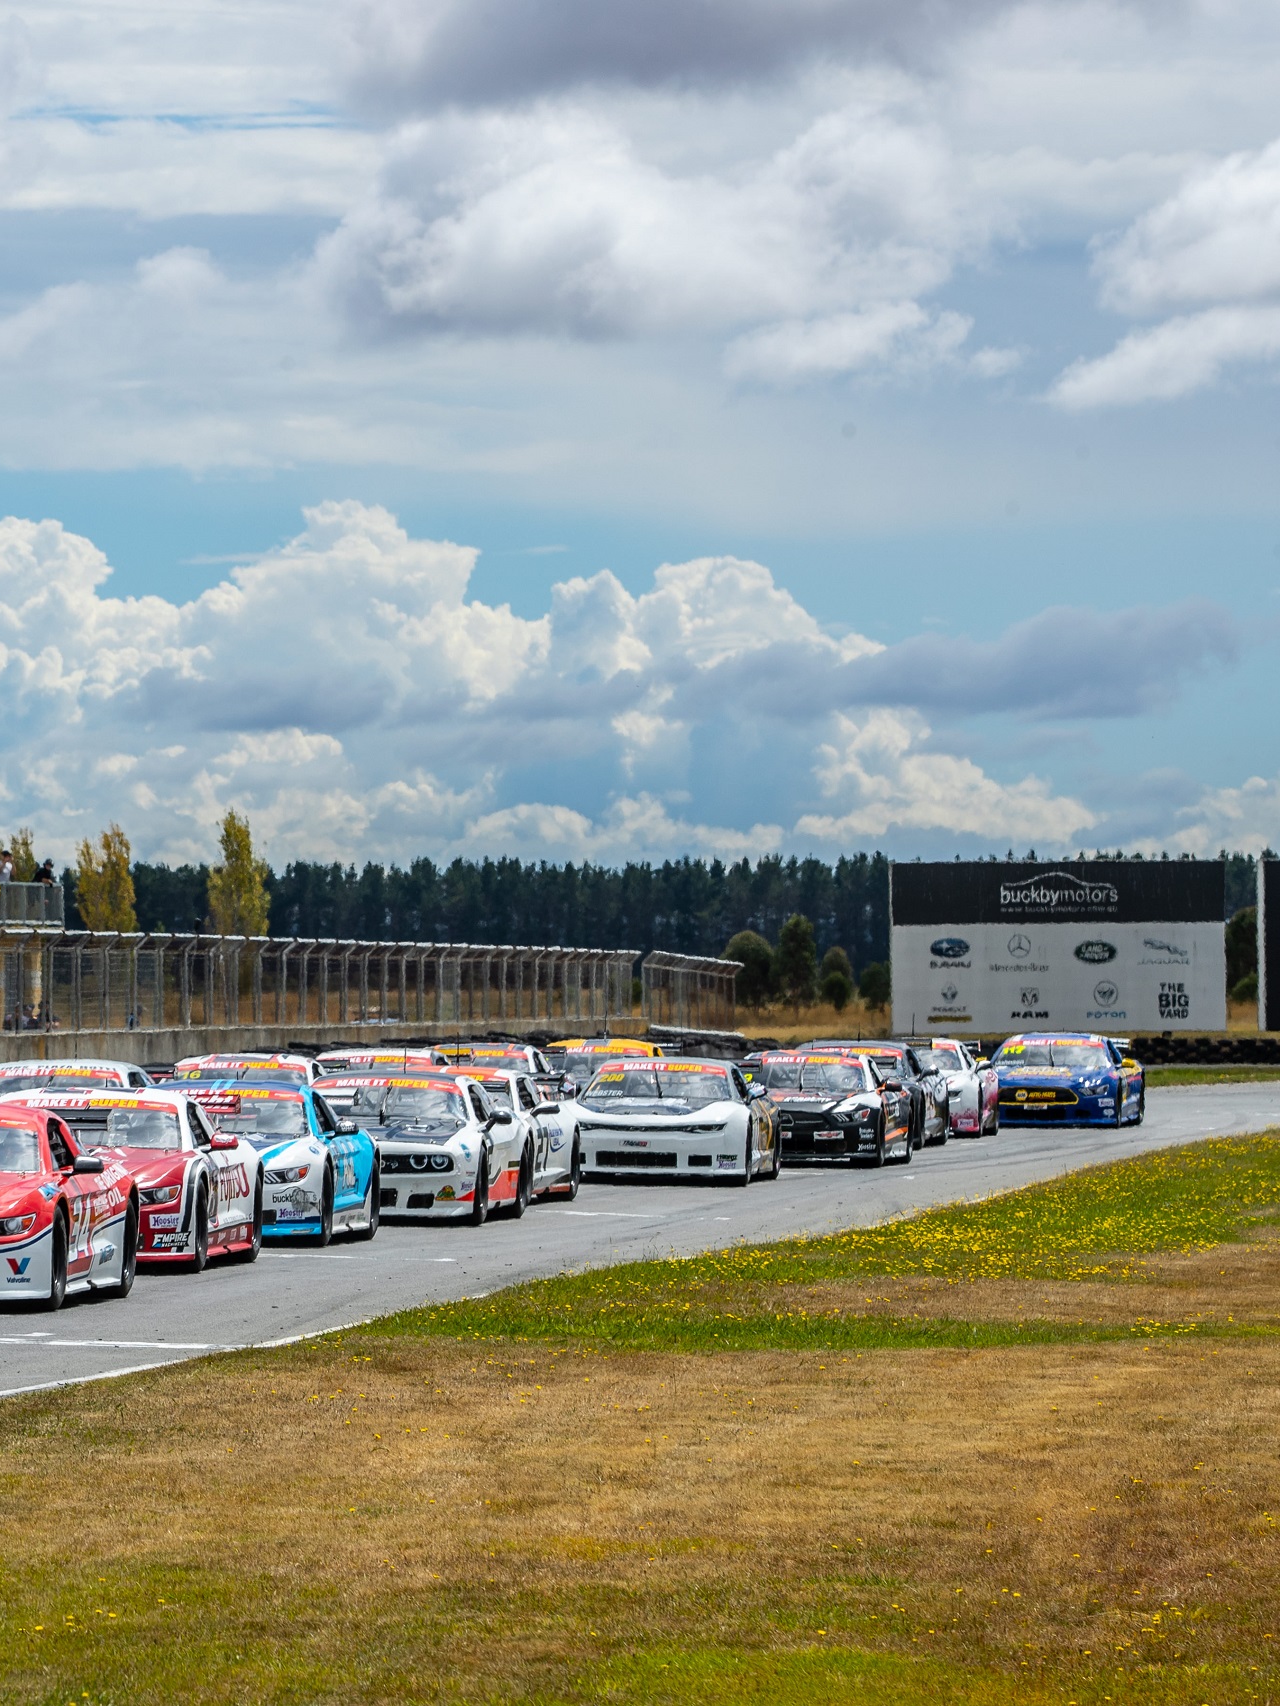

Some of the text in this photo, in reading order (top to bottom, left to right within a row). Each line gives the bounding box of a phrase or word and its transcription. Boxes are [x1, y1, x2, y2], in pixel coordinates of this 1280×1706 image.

[1000, 884, 1119, 906] buckbymotors
[1159, 982, 1185, 993] THE
[1158, 994, 1190, 1008] BIG
[1159, 1008, 1189, 1019] YARD
[807, 1056, 841, 1064] SUPER
[198, 1061, 279, 1069] MAKE IT SUPER
[623, 1063, 702, 1072] MAKE IT SUPER
[5, 1068, 92, 1076] MAKE IT SUPER
[183, 1070, 201, 1079] 16
[599, 1073, 625, 1082] 200
[335, 1079, 371, 1087] MAKE
[388, 1079, 429, 1088] SUPER
[586, 1089, 624, 1097] WEBSTER
[26, 1099, 139, 1108] MAKE IT SUPER
[108, 1186, 126, 1207] OIL
[152, 1215, 179, 1228] Hoosier
[152, 1232, 189, 1247] EMPIRE
